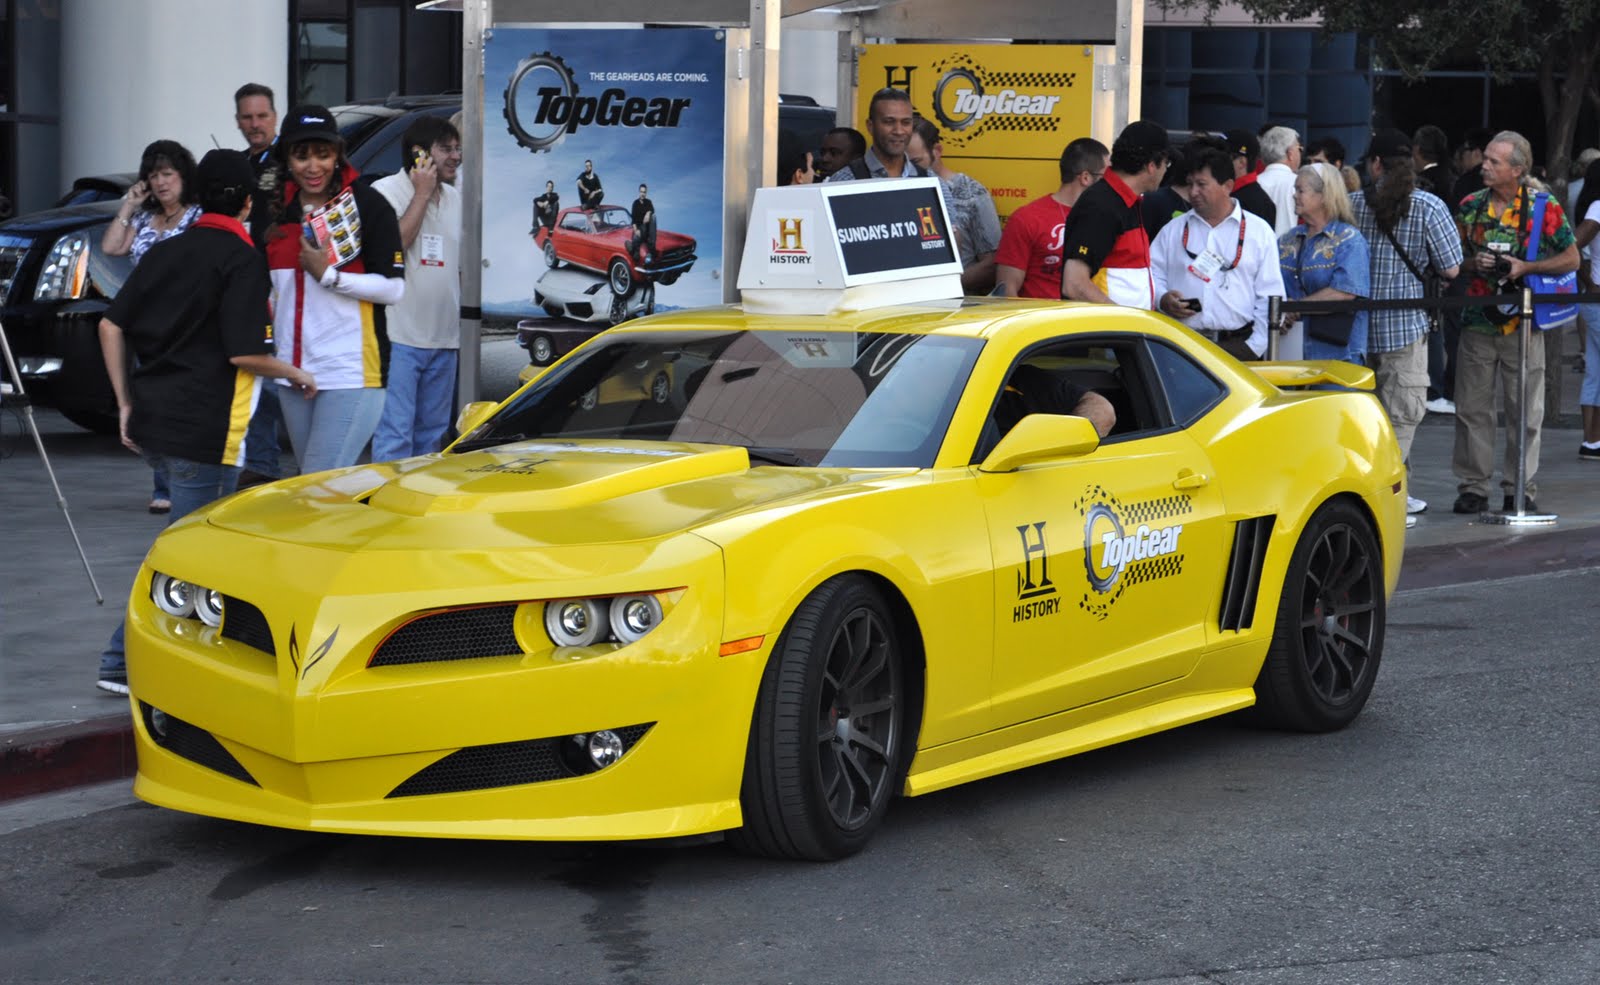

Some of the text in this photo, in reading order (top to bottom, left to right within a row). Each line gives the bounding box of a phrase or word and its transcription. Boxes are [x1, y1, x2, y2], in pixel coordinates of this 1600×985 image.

[590, 72, 709, 82] THE GEARHEADS ARE COMING.
[534, 87, 691, 134] TopGear
[953, 89, 1060, 120] TopGear
[991, 188, 1027, 198] NOTICE
[837, 221, 918, 244] SUNDAYS AT 10
[920, 239, 946, 250] HISTORY
[770, 255, 812, 264] HISTORY
[1016, 521, 1053, 591] H
[1101, 524, 1183, 573] TopGear
[1013, 597, 1061, 623] HISTORY
